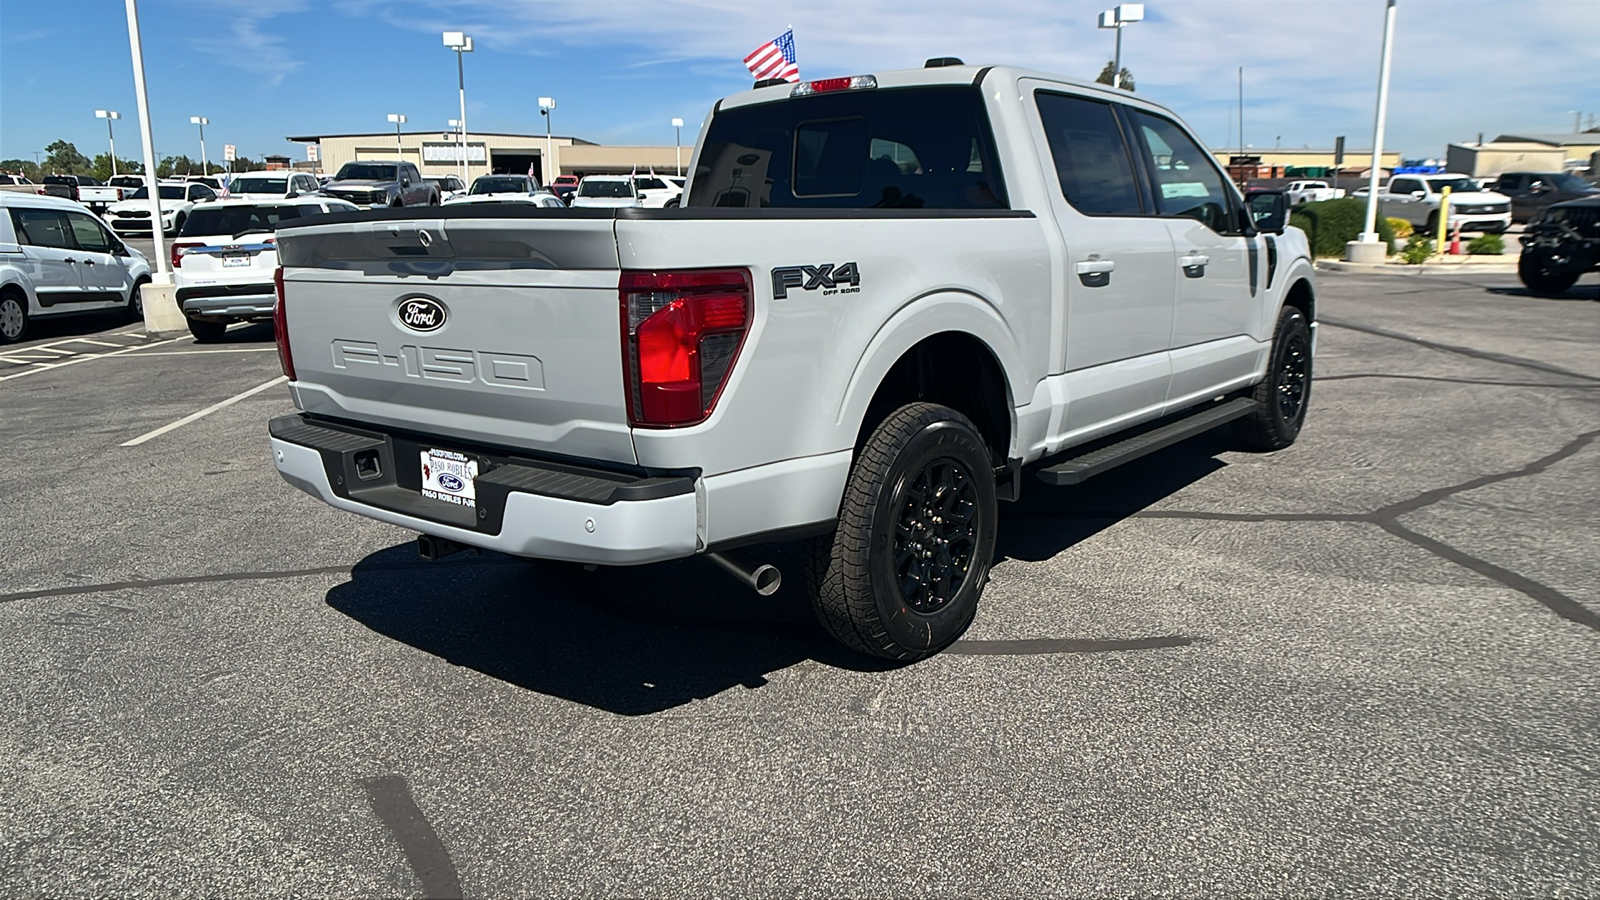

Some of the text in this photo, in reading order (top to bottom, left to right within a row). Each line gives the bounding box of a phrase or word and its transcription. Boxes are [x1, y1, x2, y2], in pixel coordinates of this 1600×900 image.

[771, 262, 860, 299] FX4
[405, 302, 436, 326] Ford
[331, 338, 546, 391] F-150
[430, 459, 473, 482] PASO ROBLES
[442, 475, 459, 489] Ford
[421, 488, 437, 500] PASO
[437, 492, 462, 505] ROBLES
